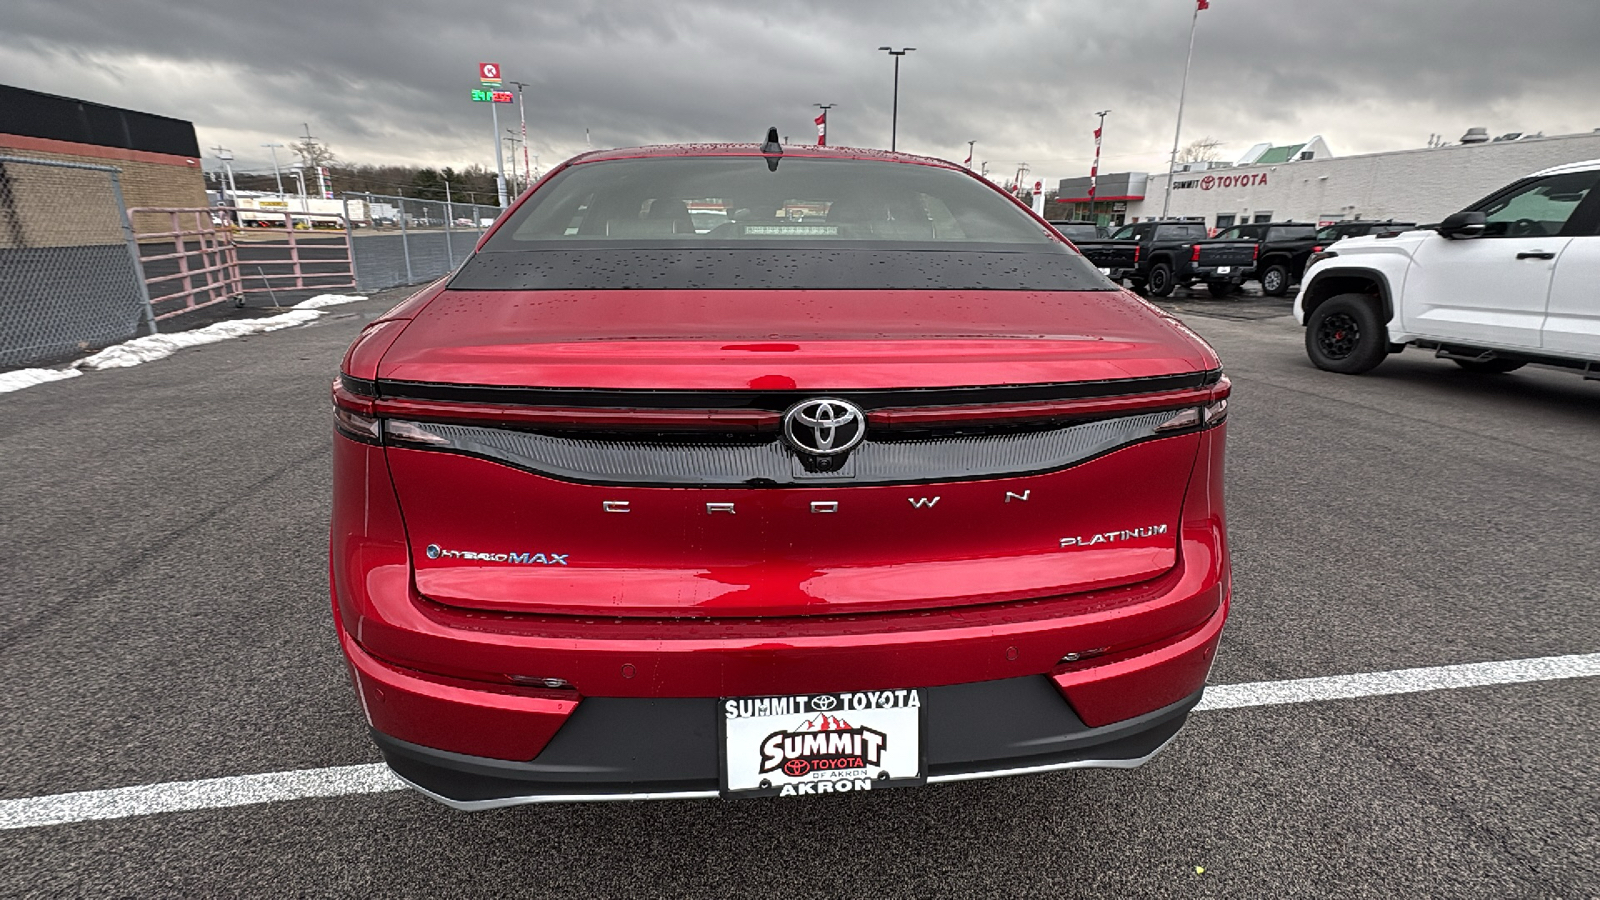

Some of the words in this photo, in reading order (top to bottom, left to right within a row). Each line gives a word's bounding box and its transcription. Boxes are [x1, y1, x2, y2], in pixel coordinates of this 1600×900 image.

[1172, 179, 1200, 190] SUMMIT
[1216, 173, 1268, 188] TOYOTA
[1059, 524, 1168, 548] PLATINUM
[725, 696, 808, 718] SUMMIT
[840, 690, 921, 711] TOYOTA
[761, 726, 886, 774] SUMMIT
[811, 757, 864, 770] TOYOTA
[812, 771, 828, 779] OF
[830, 769, 868, 779] AKRON
[780, 779, 872, 797] AKRON
